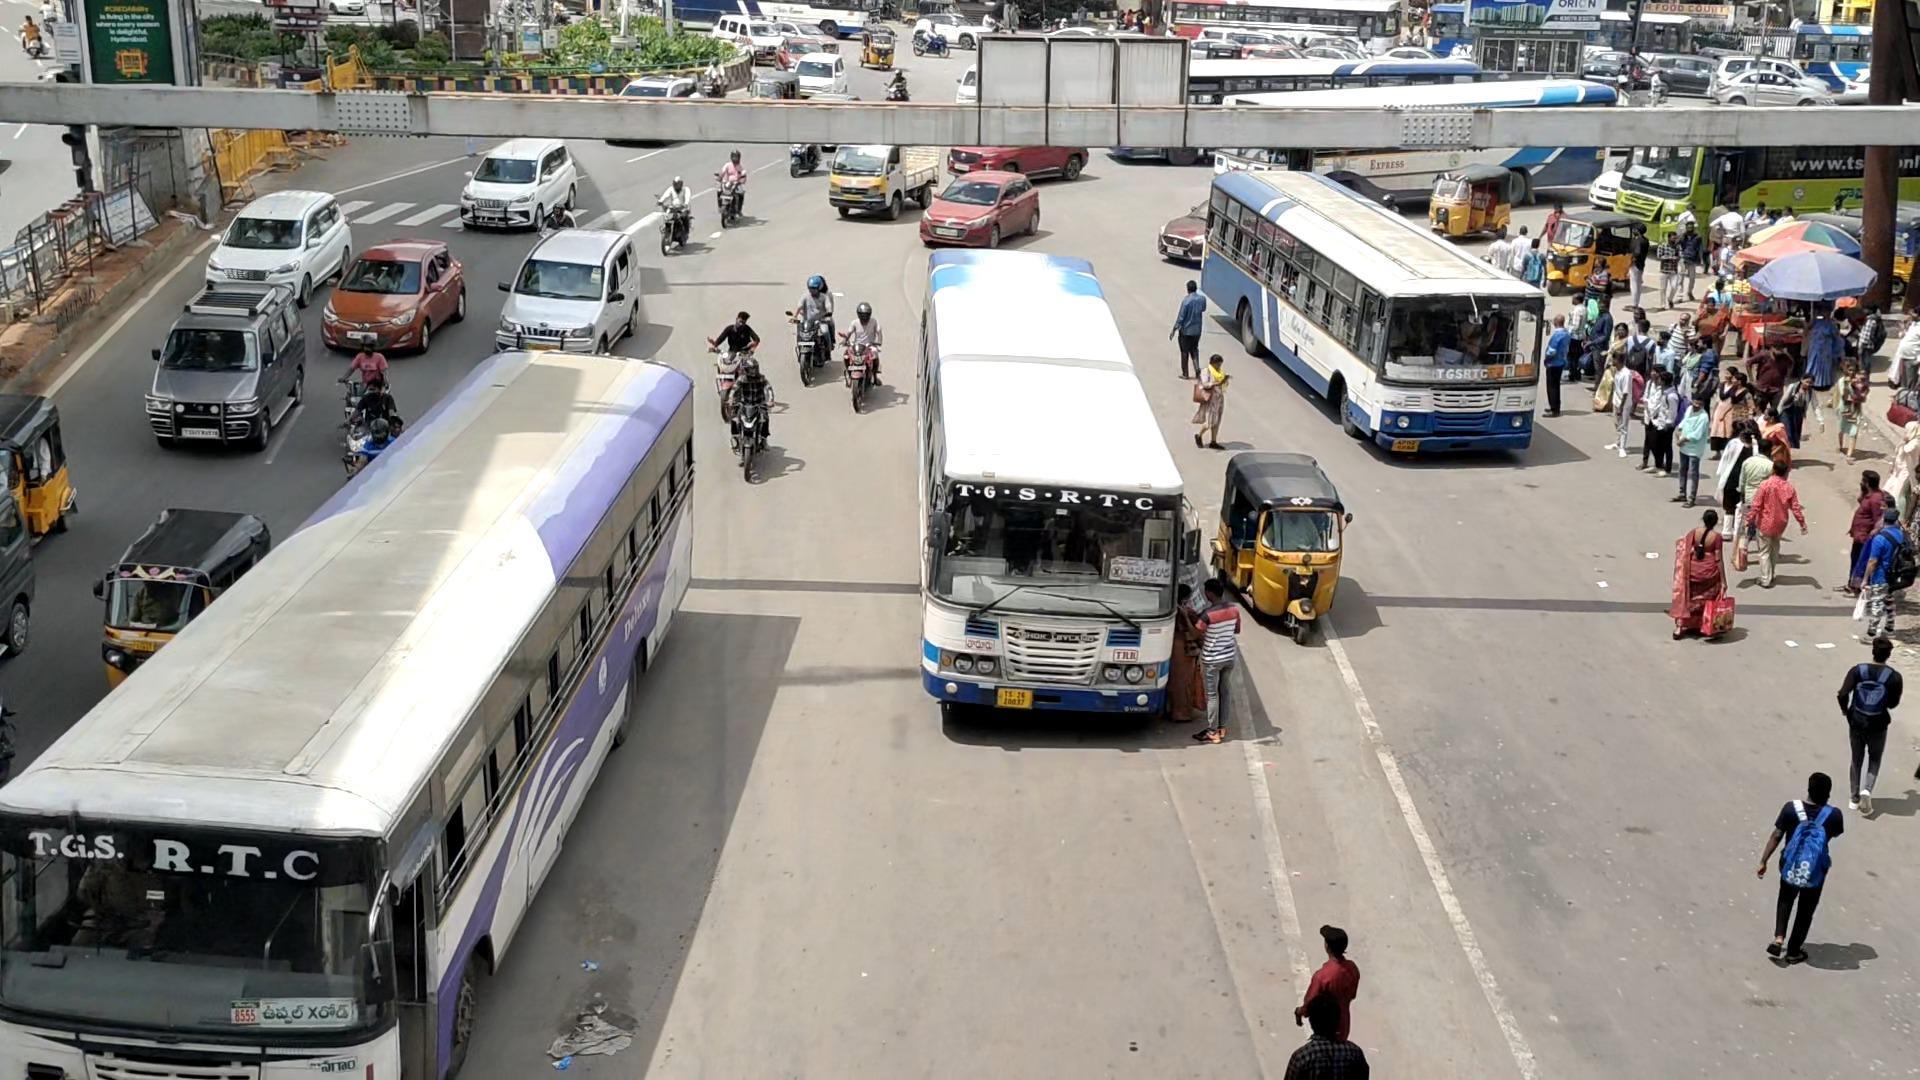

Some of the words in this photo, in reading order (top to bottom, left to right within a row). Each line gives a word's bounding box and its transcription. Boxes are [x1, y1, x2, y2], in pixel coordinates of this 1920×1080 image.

[1655, 4, 1685, 12] FOOD
[28, 832, 125, 859] T.G.S.
[152, 839, 320, 881] R.T.C
[234, 1009, 256, 1022] 8555
